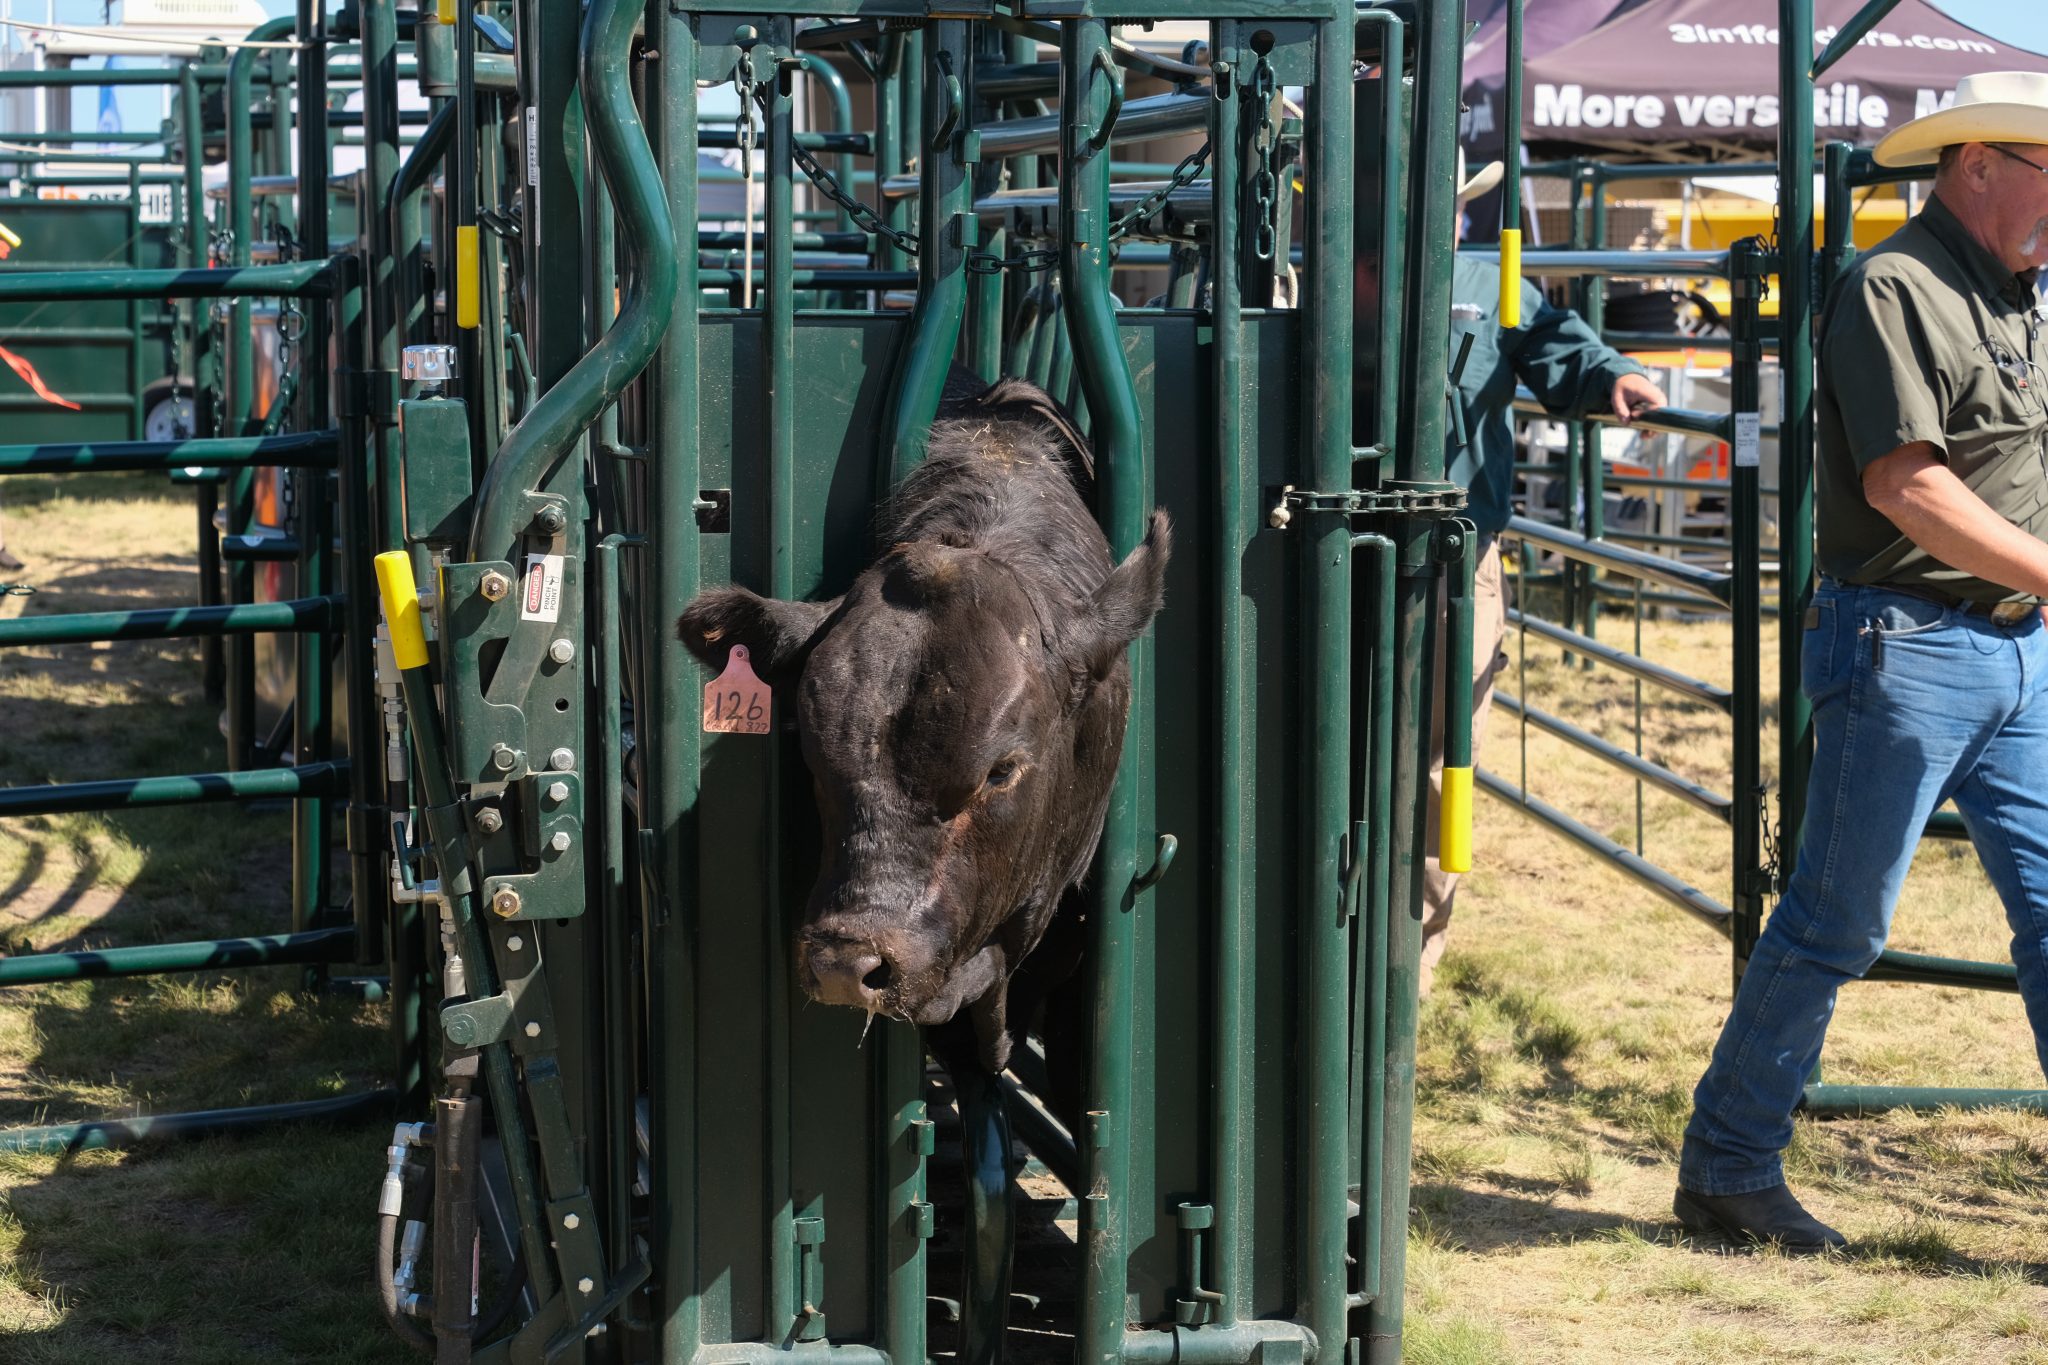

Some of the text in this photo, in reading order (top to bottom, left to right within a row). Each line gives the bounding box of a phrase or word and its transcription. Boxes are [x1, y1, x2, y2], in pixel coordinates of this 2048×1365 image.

[1534, 84, 1666, 128] More
[1674, 82, 1889, 128] verstile
[530, 571, 541, 606] DANGER
[715, 691, 763, 720] 126
